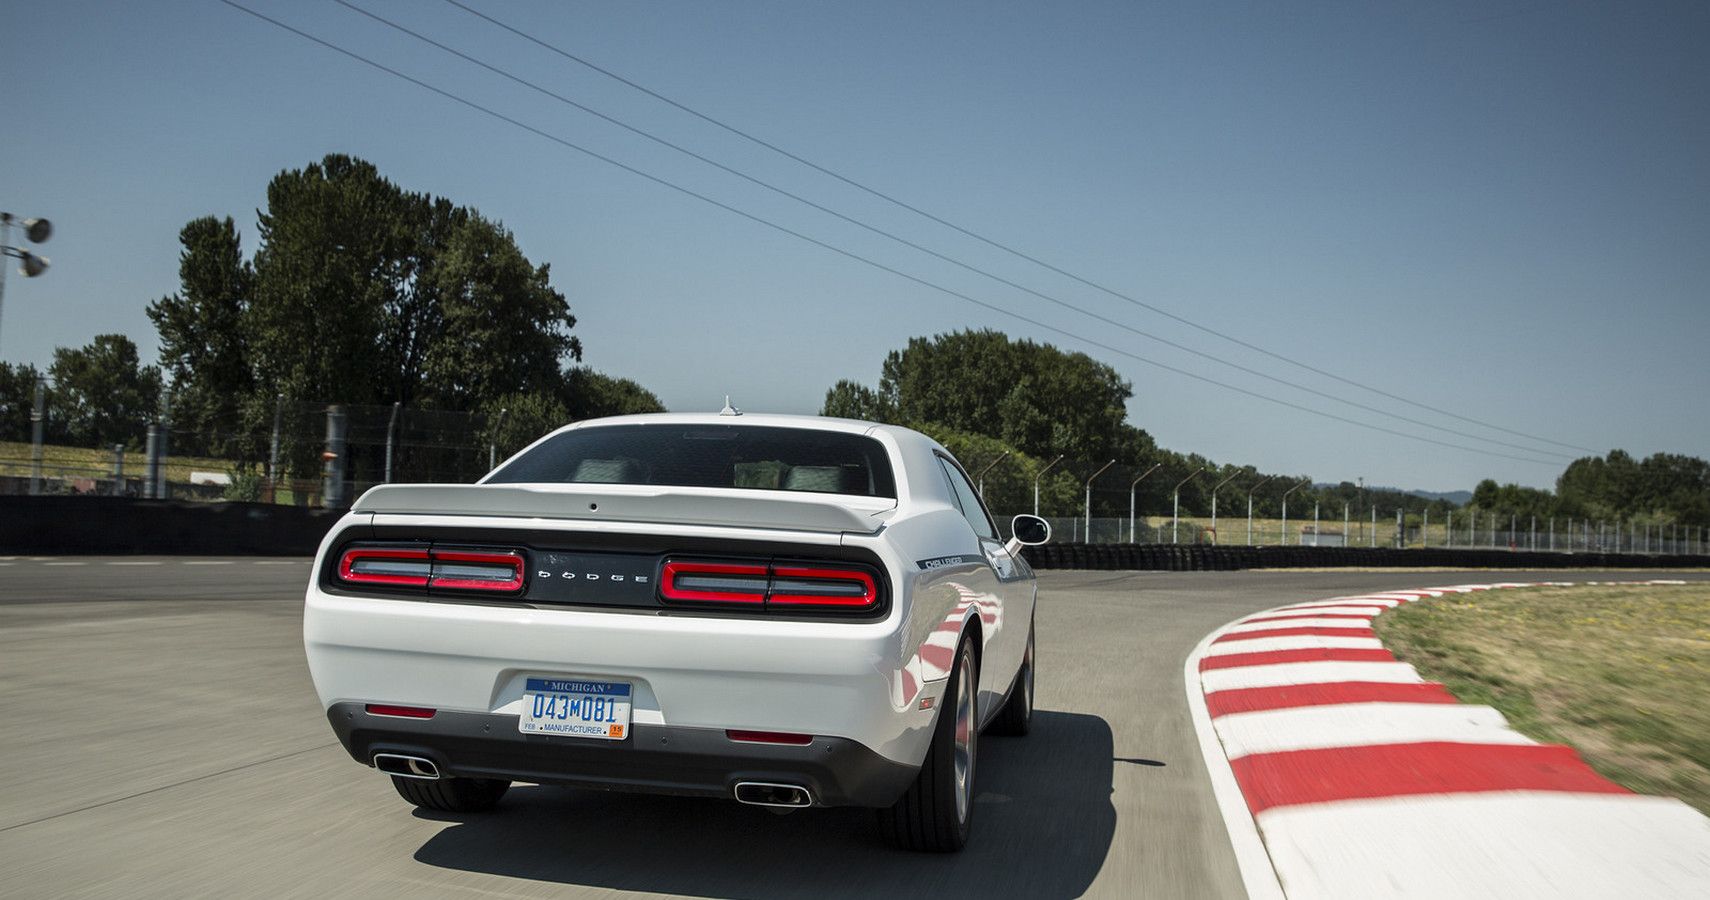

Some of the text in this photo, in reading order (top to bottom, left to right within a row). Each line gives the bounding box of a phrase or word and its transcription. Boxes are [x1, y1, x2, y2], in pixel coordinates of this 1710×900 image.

[538, 570, 649, 583] DODGE
[551, 682, 605, 693] MICHIGAN
[533, 694, 616, 722] 043M081
[544, 723, 603, 734] MANUFACTURER
